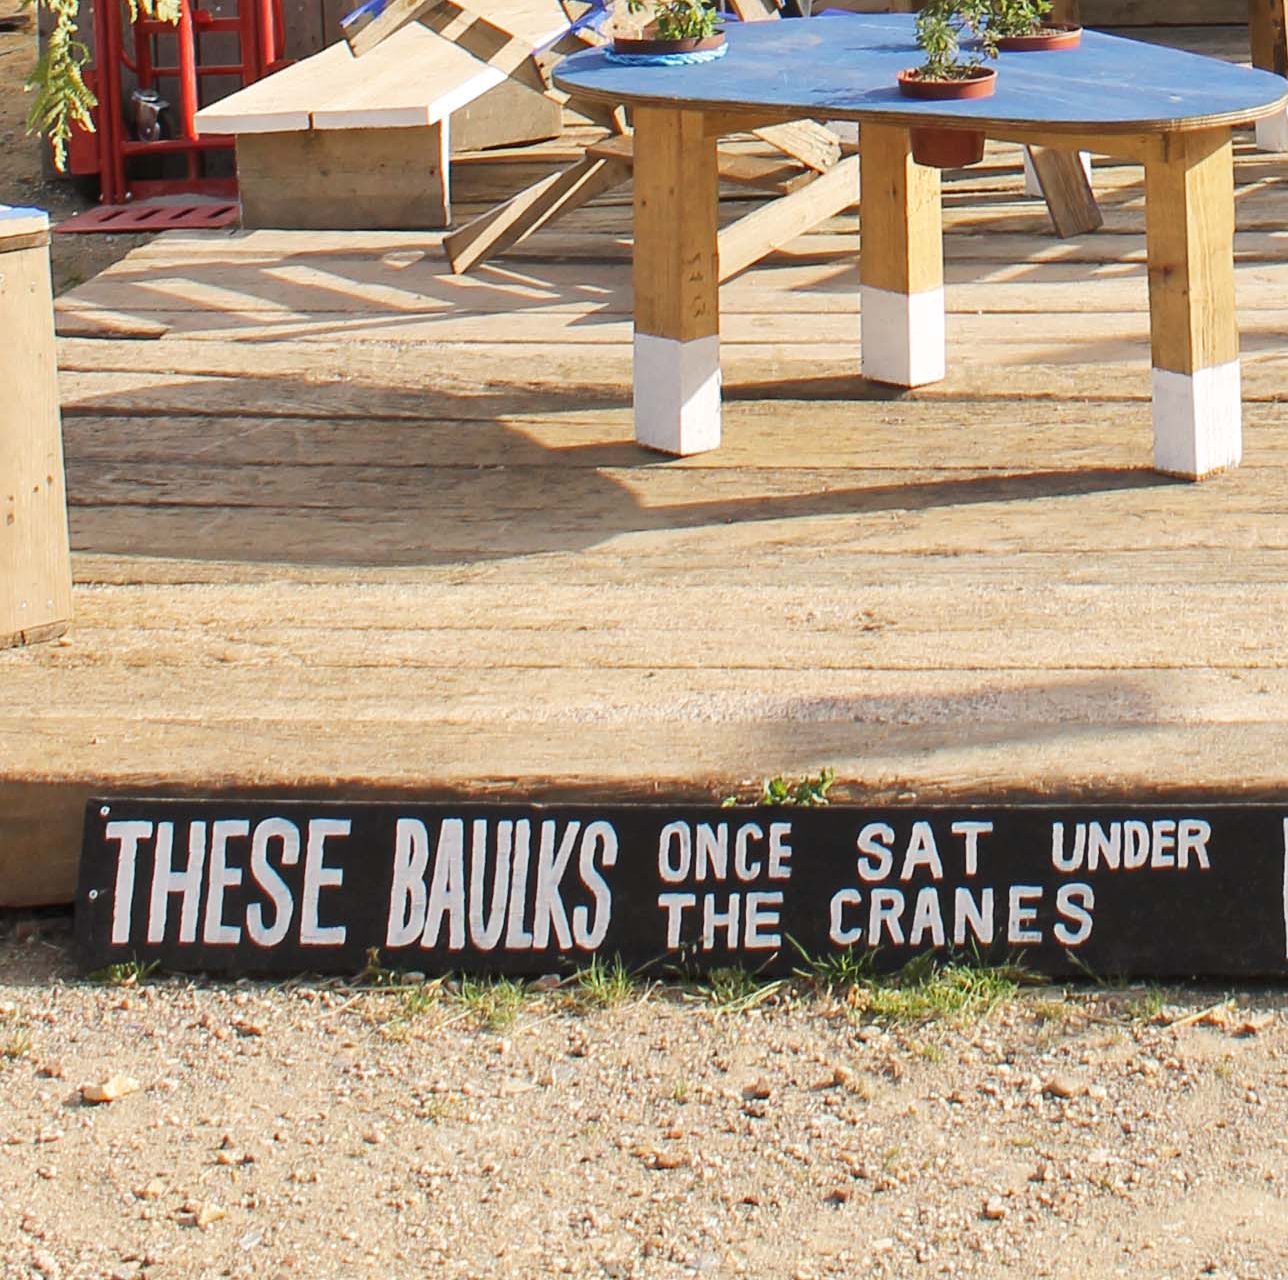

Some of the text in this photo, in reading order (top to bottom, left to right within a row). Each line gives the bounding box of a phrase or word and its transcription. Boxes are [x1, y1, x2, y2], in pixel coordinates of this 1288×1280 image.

[104, 816, 620, 951] THESE BAULKS
[657, 818, 1211, 883] ONCE SAT UNDER
[657, 882, 1096, 950] THE CRANES
